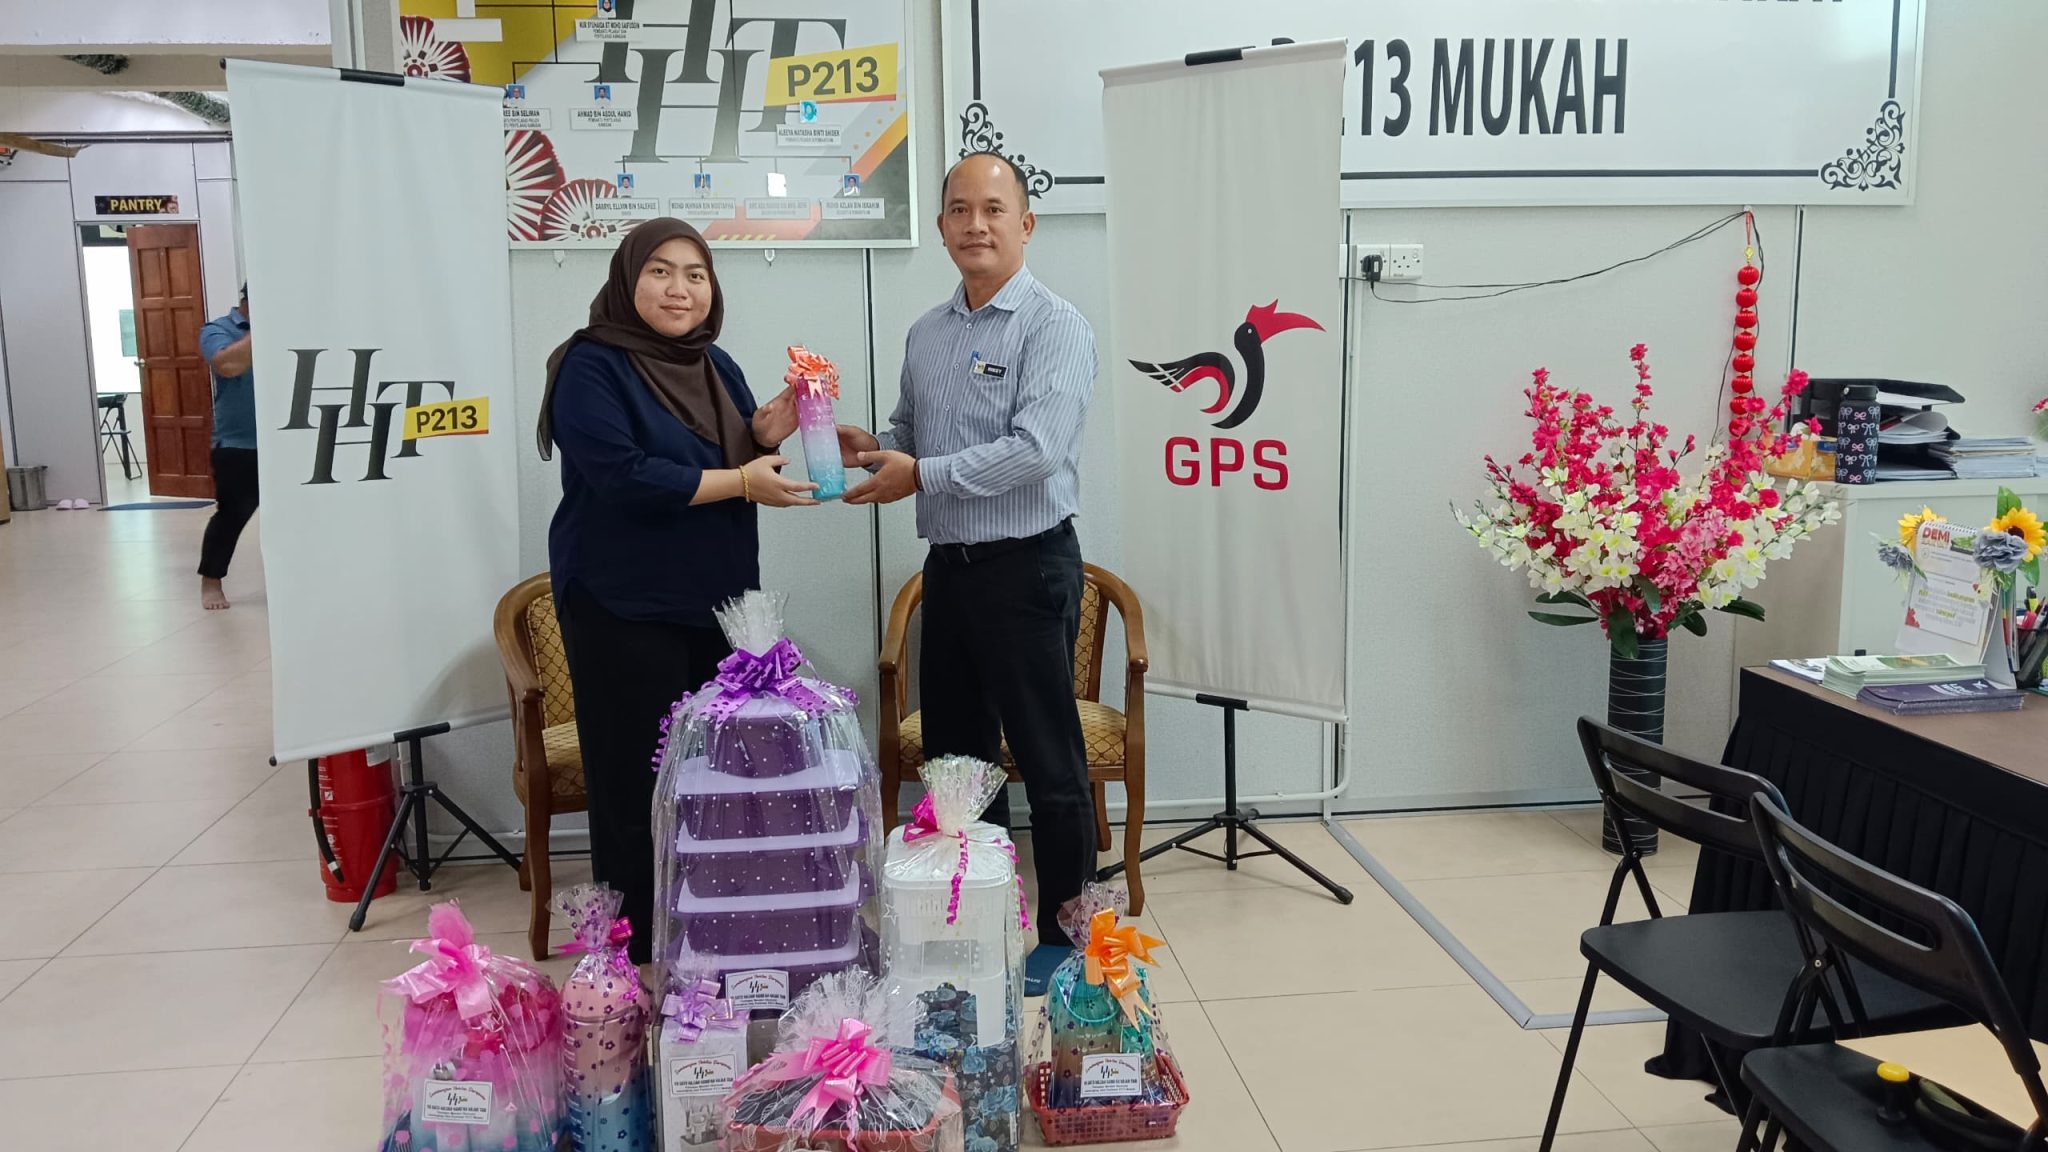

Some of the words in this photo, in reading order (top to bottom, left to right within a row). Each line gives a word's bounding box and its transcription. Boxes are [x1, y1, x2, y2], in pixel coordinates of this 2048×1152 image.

[787, 56, 879, 97] P213
[1429, 38, 1628, 136] MUKAH
[110, 199, 162, 211] PANTRY
[416, 405, 478, 433] P213
[1165, 436, 1289, 490] GPS
[1922, 527, 1951, 543] DEMI
